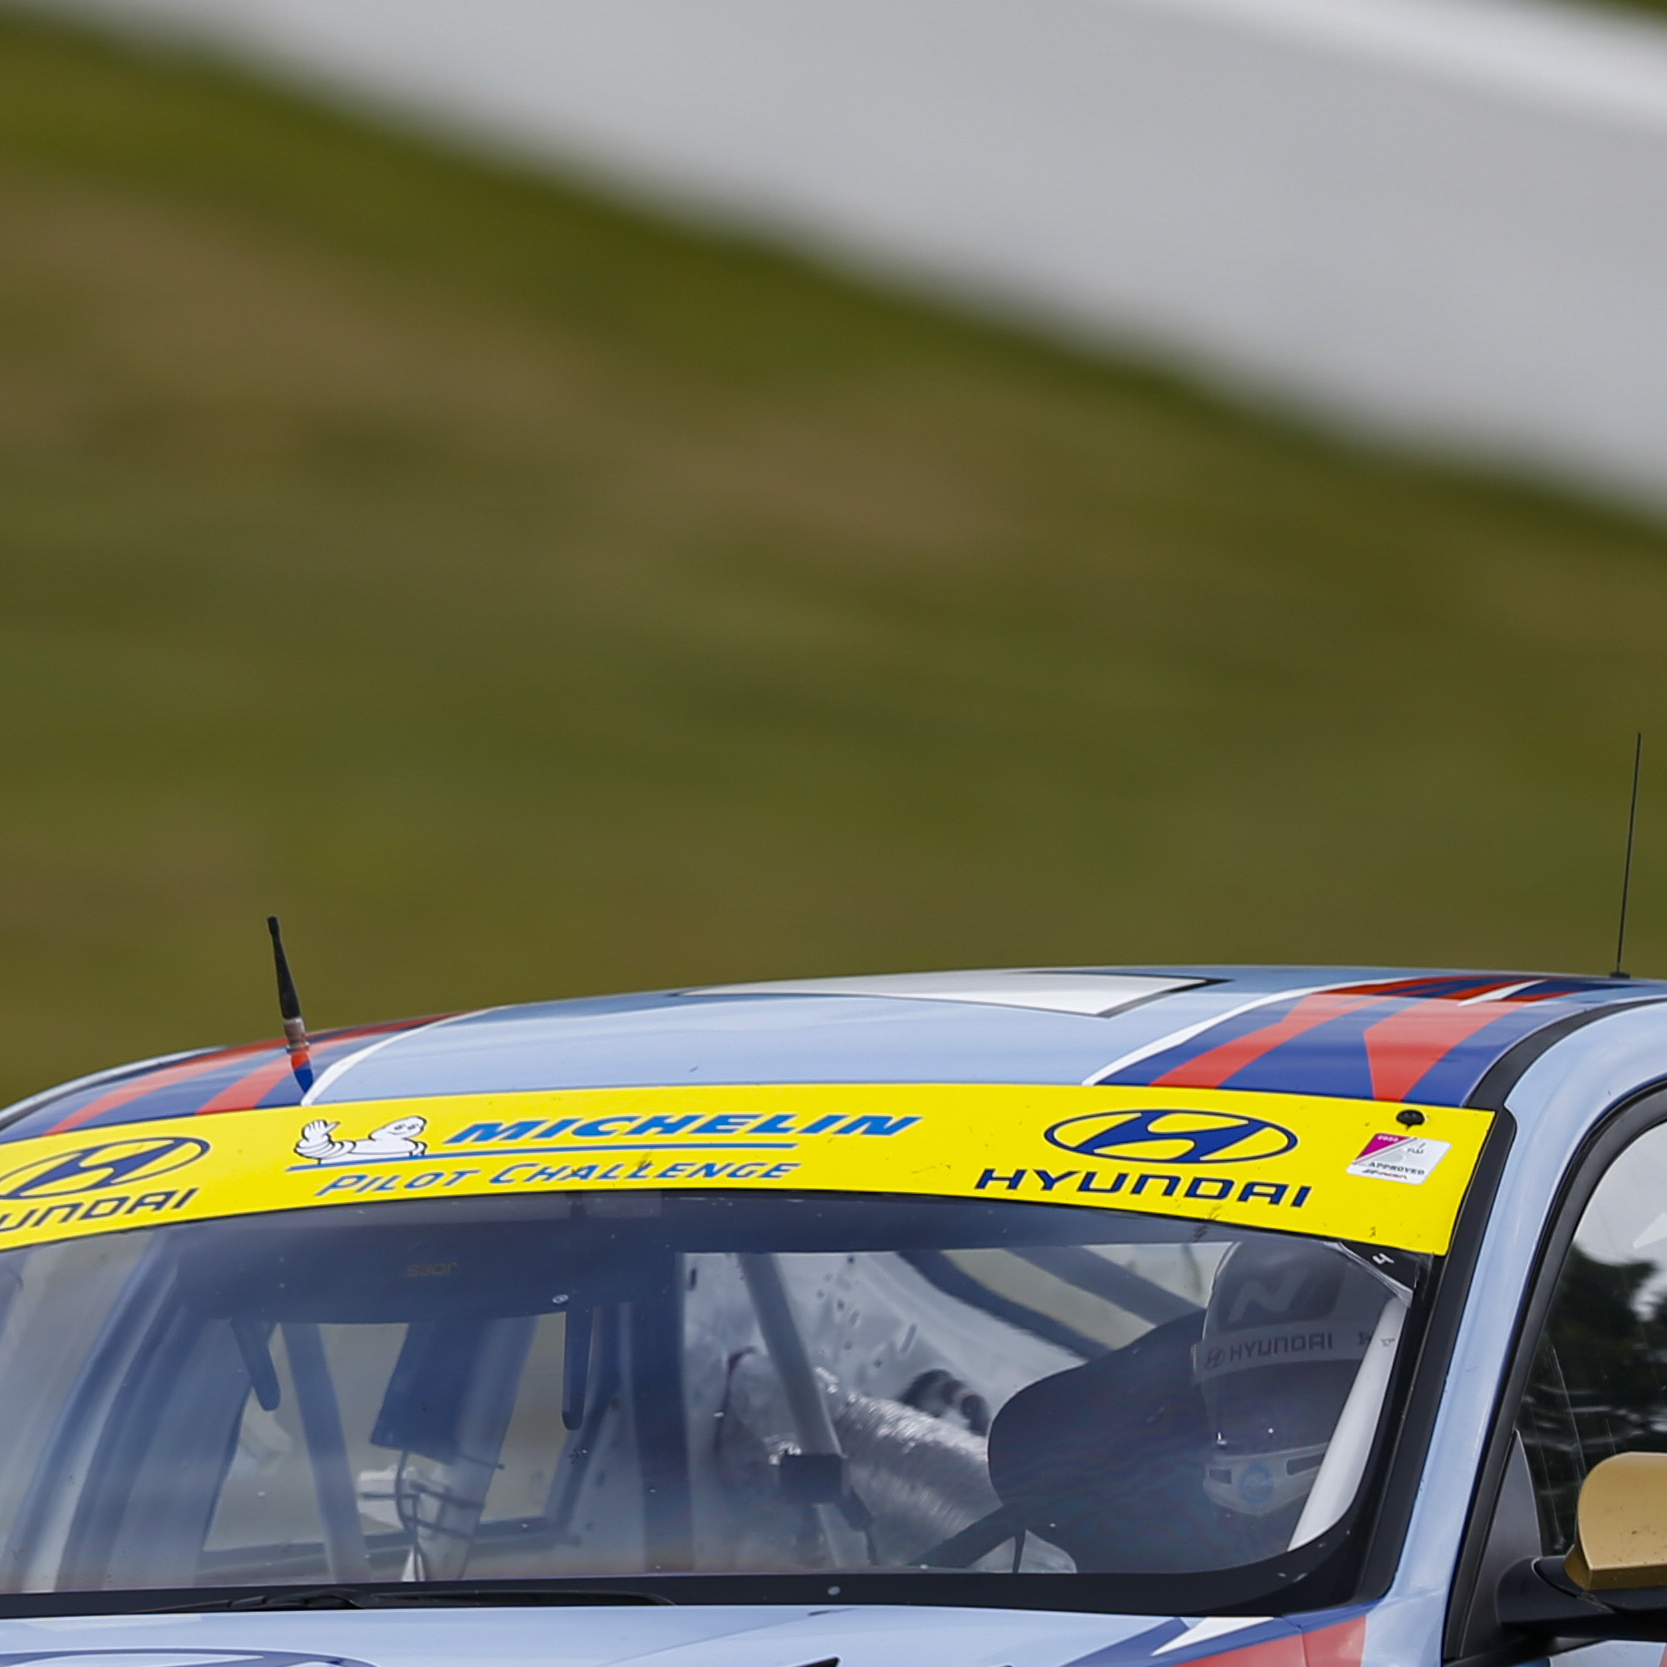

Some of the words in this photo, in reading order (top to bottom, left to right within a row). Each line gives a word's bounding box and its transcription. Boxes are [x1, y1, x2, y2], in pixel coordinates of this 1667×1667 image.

[441, 1112, 924, 1145] MICHELIN
[314, 1168, 481, 1197] PILOT
[487, 1161, 802, 1185] CHALLENGE
[973, 1167, 1313, 1209] HYUNDAI
[1229, 1331, 1333, 1362] HYUNDAI
